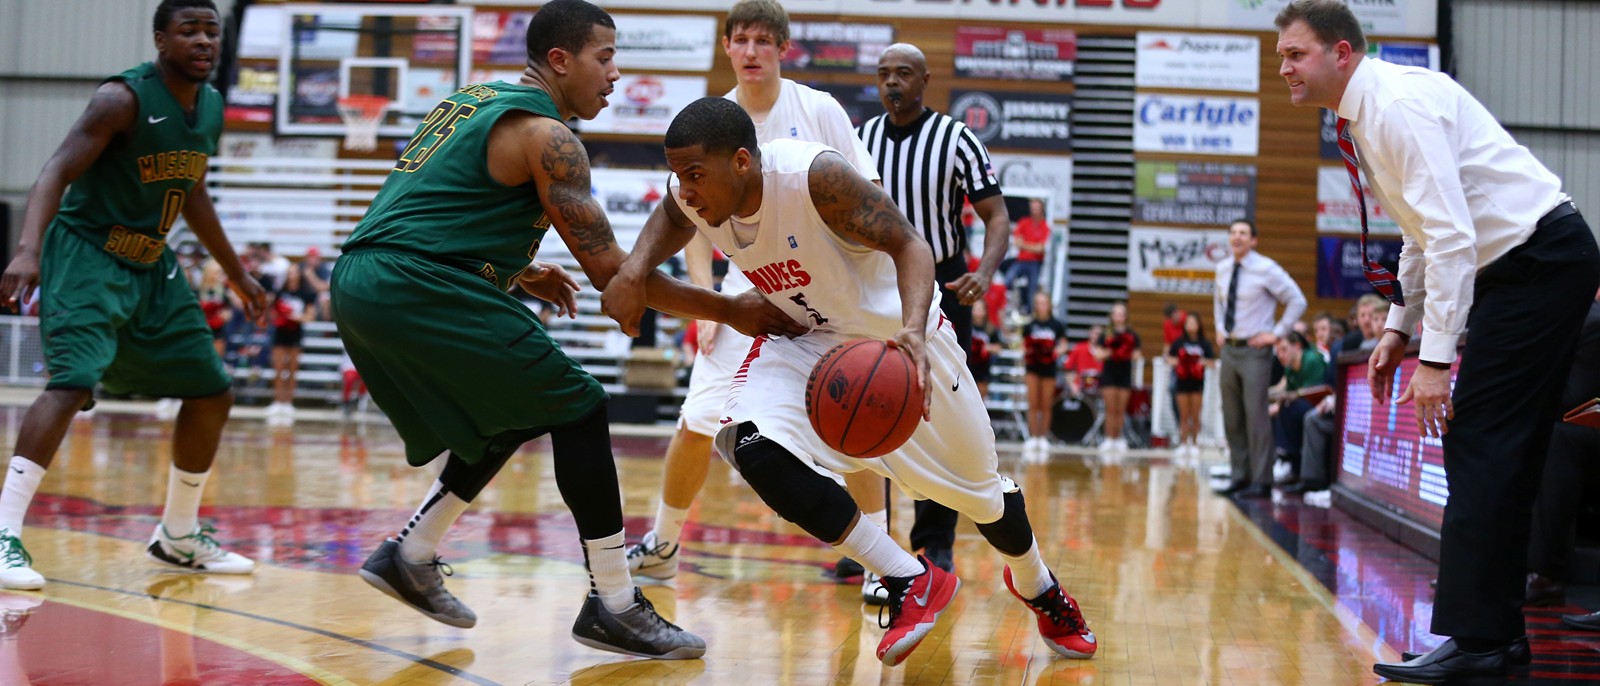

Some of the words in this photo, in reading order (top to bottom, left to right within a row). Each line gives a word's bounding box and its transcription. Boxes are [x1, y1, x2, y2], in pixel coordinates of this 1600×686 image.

[1003, 101, 1071, 119] JIMMY
[1140, 96, 1255, 129] Carlyle
[393, 99, 477, 173] 25
[1001, 121, 1071, 139] JOHN'S
[158, 189, 186, 235] 0
